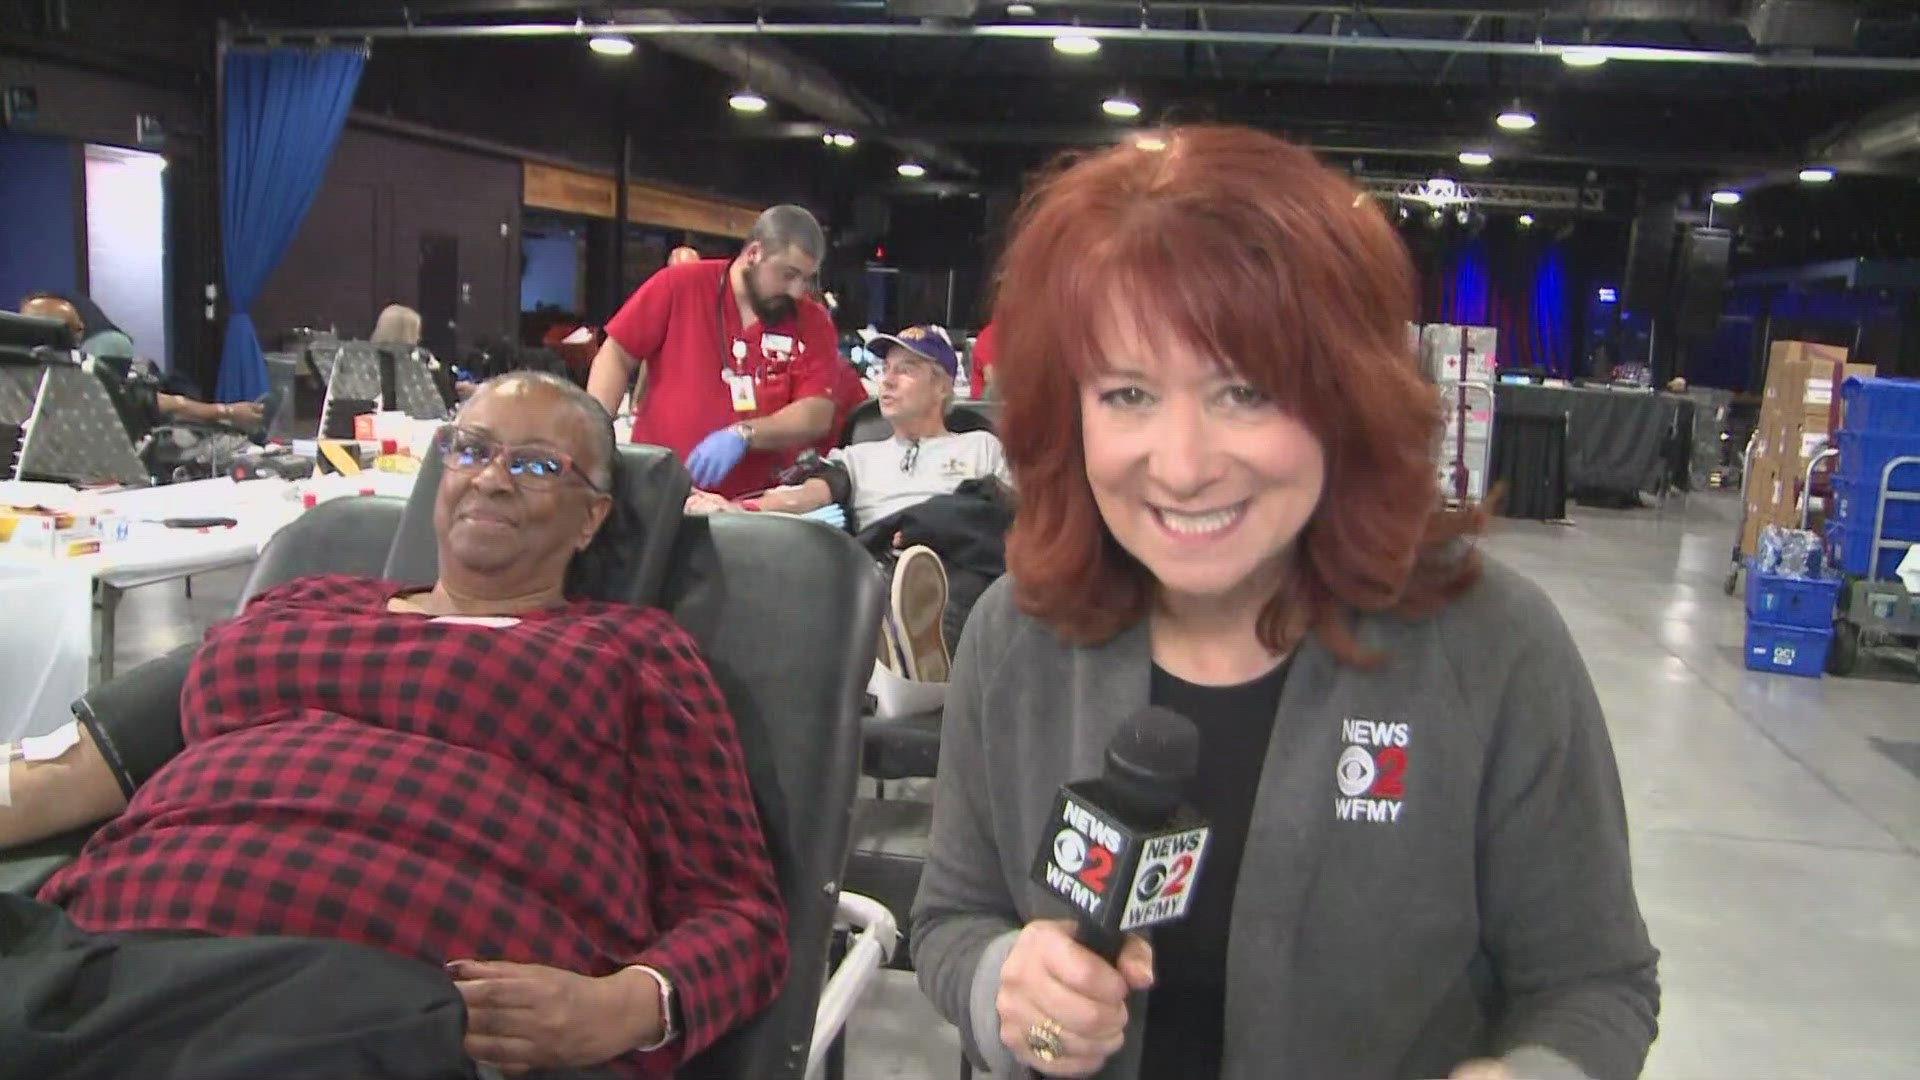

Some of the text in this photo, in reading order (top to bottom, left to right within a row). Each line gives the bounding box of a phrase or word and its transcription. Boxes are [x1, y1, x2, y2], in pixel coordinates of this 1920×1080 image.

[1341, 718, 1409, 747] NEWS
[1371, 747, 1408, 798] 2
[1063, 799, 1121, 854] NEWS
[1335, 798, 1402, 822] WFMY
[1147, 833, 1200, 860] NEWS
[1046, 861, 1101, 913] WFMY
[1079, 845, 1113, 892] 2
[1160, 855, 1193, 897] 2
[1129, 898, 1180, 925] WFMY
